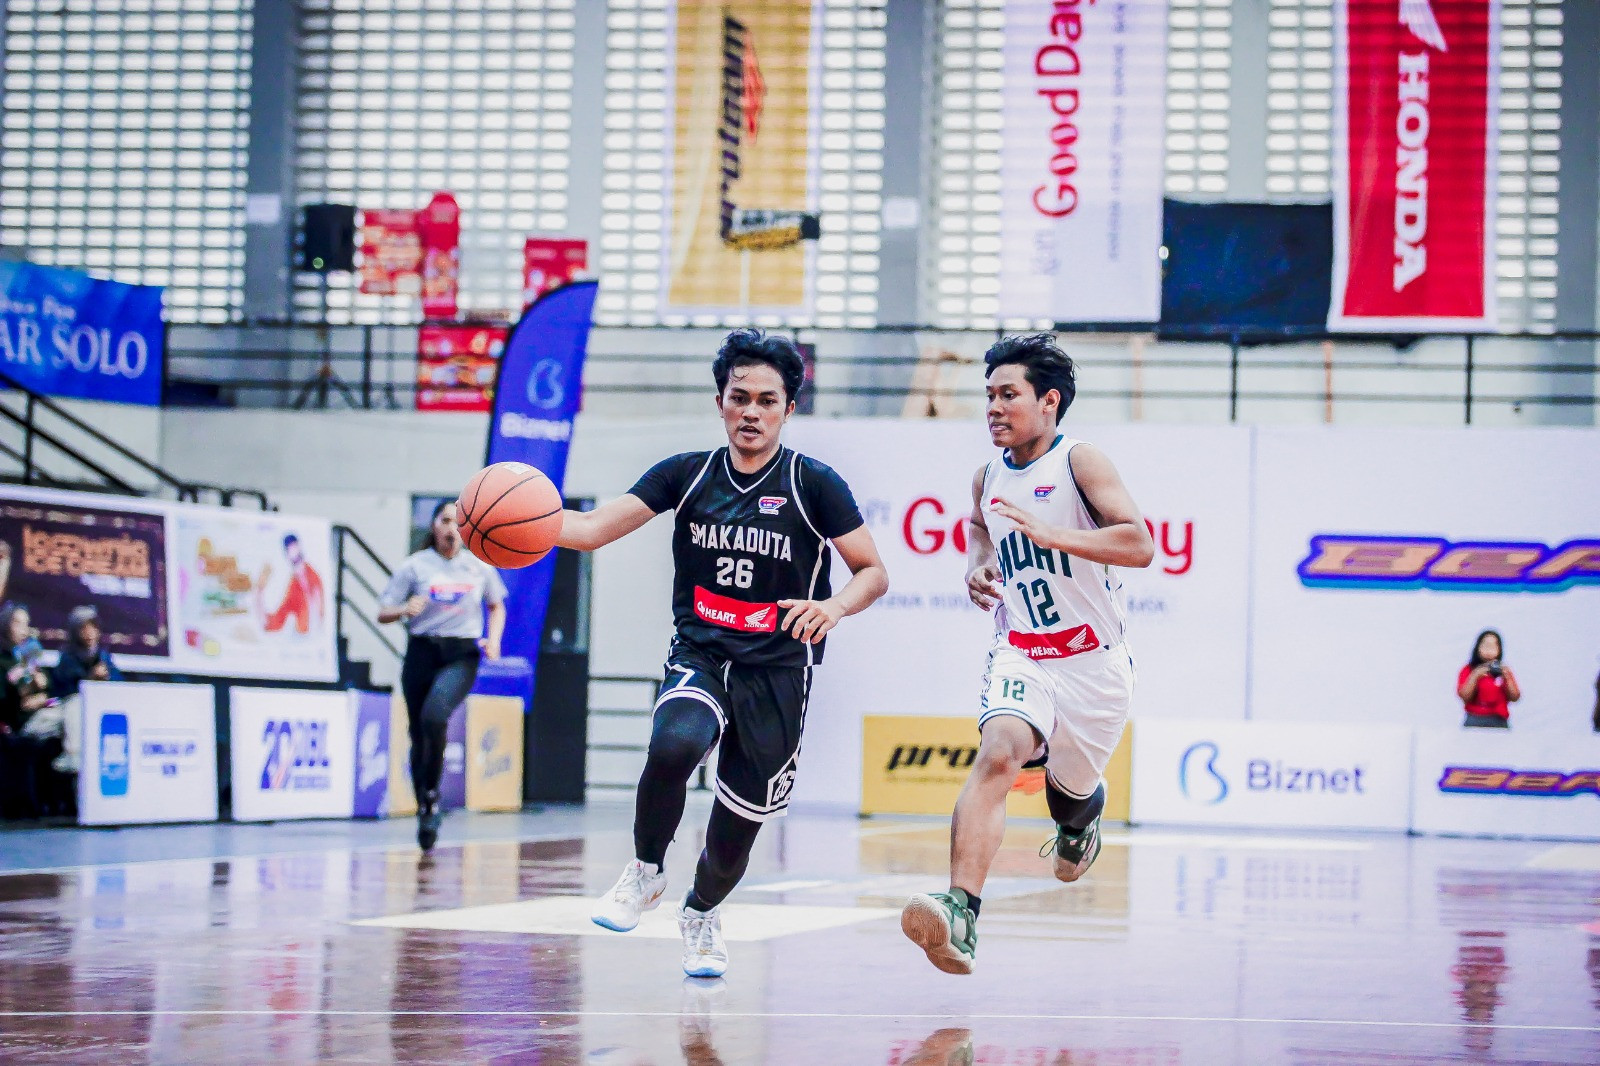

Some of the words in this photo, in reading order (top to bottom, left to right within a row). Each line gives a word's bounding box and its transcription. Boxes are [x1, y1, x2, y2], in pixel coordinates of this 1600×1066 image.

[1034, 0, 1096, 77] Da
[1032, 88, 1080, 218] Good
[1393, 51, 1430, 292] HONDA
[51, 323, 148, 379] SOLO
[690, 522, 792, 562] SMAKADUTA
[902, 497, 971, 555] Go
[716, 557, 754, 588] 26
[1017, 578, 1061, 629] 12
[1002, 678, 1025, 701] 12
[772, 770, 796, 802] 26
[1247, 759, 1366, 793] Biznet
